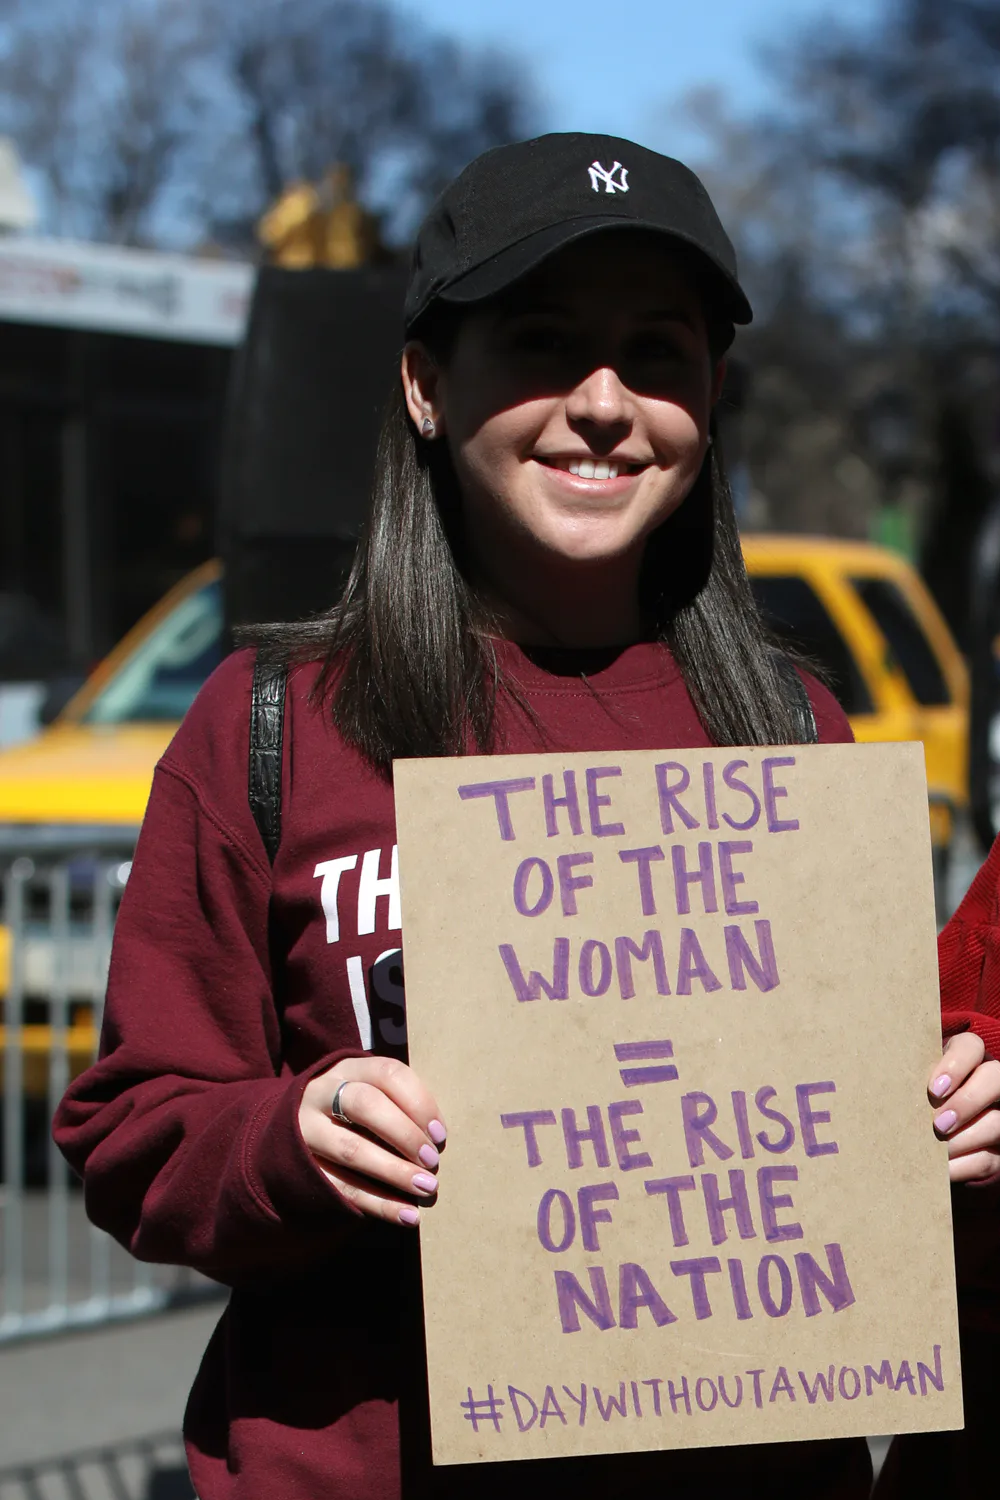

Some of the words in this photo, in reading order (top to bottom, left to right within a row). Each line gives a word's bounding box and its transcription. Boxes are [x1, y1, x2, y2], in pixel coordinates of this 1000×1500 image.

[458, 768, 624, 840] THE
[656, 757, 798, 834] RISE
[514, 853, 592, 916] OF
[620, 842, 759, 915] THE
[500, 920, 777, 1001] WOMAN
[501, 1102, 651, 1170] THE
[682, 1082, 838, 1166] RISE
[538, 1184, 618, 1252] OF
[644, 1166, 802, 1246] THE
[555, 1244, 854, 1332] NATION
[461, 1344, 943, 1431] #DAYWITHOUTAWOMAN
